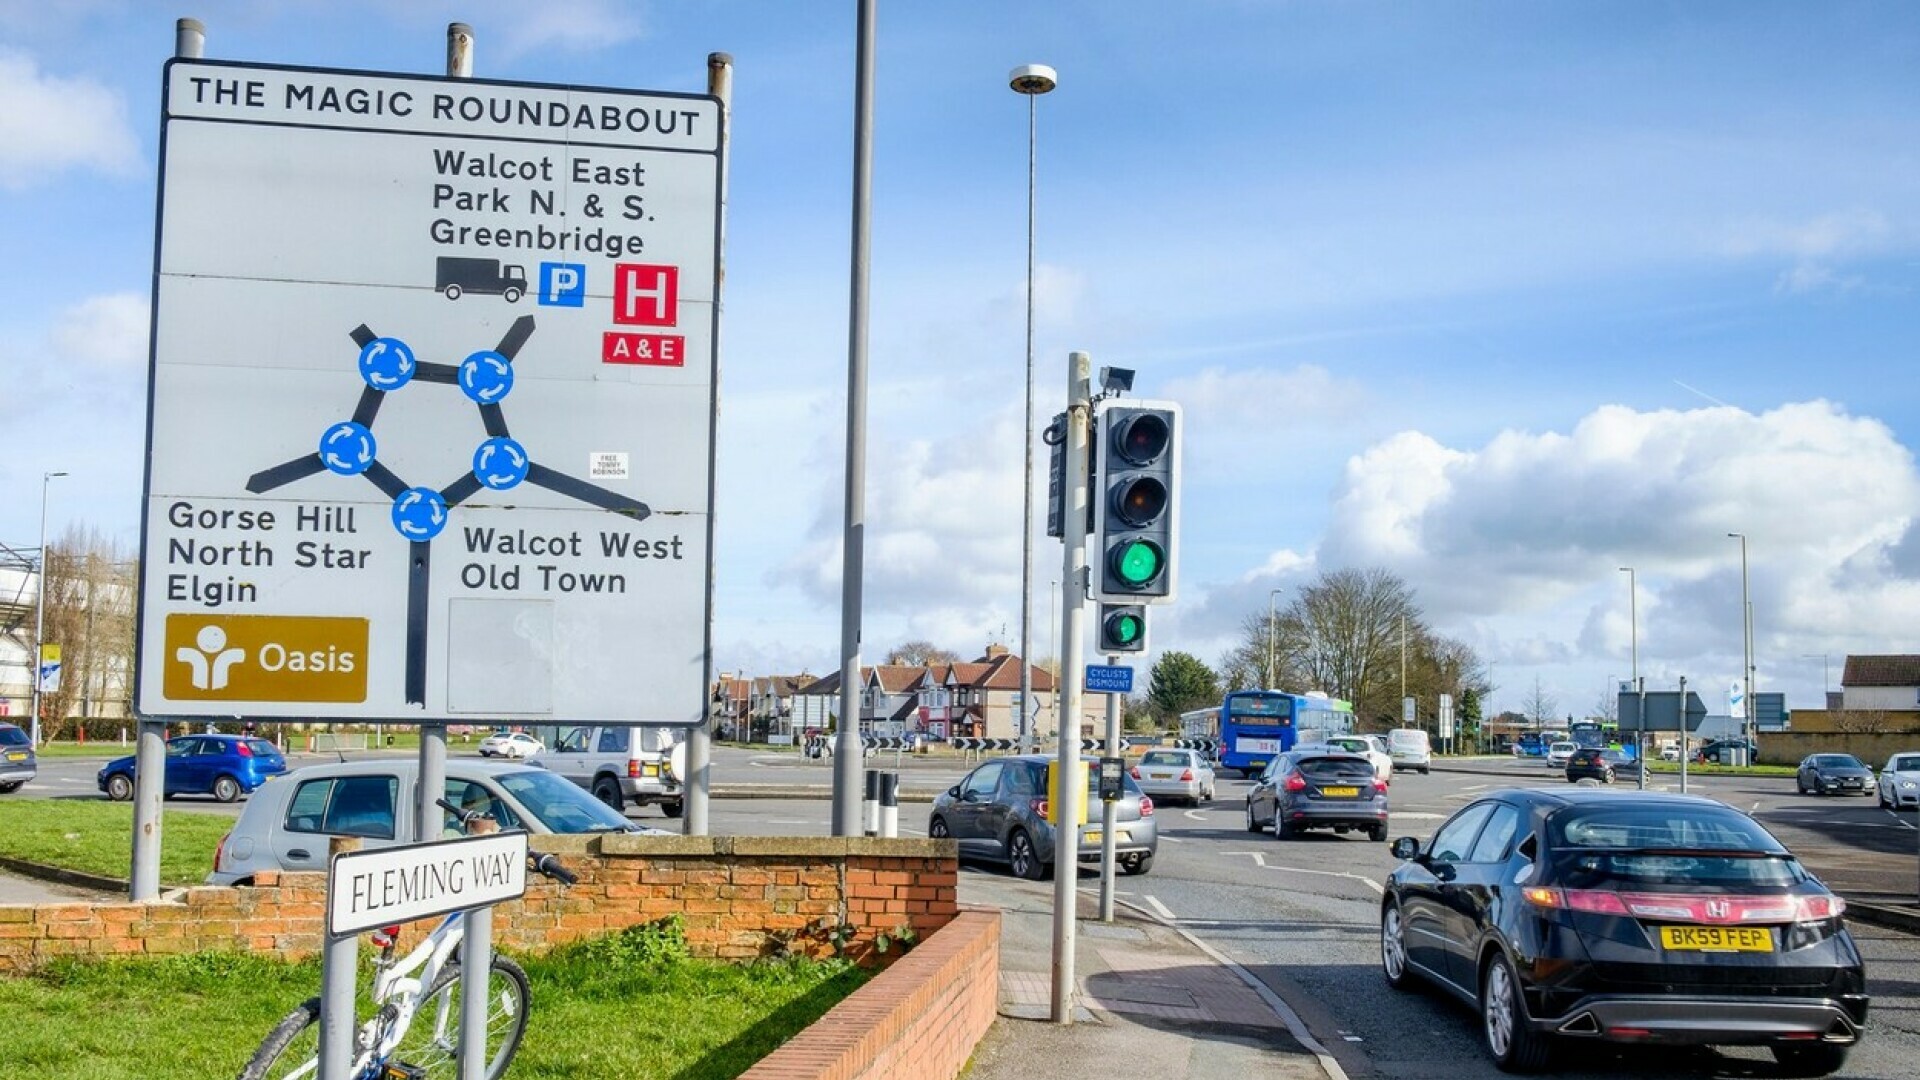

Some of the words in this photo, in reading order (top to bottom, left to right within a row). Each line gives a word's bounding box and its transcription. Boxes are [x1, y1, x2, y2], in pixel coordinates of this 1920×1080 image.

[190, 78, 265, 107] THE
[286, 84, 413, 116] MAGIC
[433, 94, 700, 136] ROUNDABOUT
[434, 149, 553, 182] Walcot
[572, 158, 646, 187] East
[433, 184, 510, 213] Park
[531, 190, 566, 217] N.
[584, 194, 605, 219] &
[623, 195, 655, 222] S.
[430, 220, 644, 258] Greenbridge
[550, 268, 579, 302] P
[626, 270, 667, 319] H
[169, 502, 276, 531] Gorse
[298, 506, 357, 533] Hill
[169, 539, 273, 567] North
[295, 542, 371, 569] Star
[464, 527, 582, 557] Walcot
[600, 532, 684, 560] West
[168, 574, 257, 607] Elgin
[462, 563, 520, 591] Old
[537, 566, 626, 593] Town
[259, 643, 355, 673] Oasis
[1091, 669, 1128, 679] CYCLISTS
[1087, 678, 1130, 688] DISMOUNT
[351, 859, 465, 914] FLEMING
[472, 851, 516, 888] WAY
[1671, 928, 1722, 945] BK59
[1726, 929, 1762, 947] FEP
